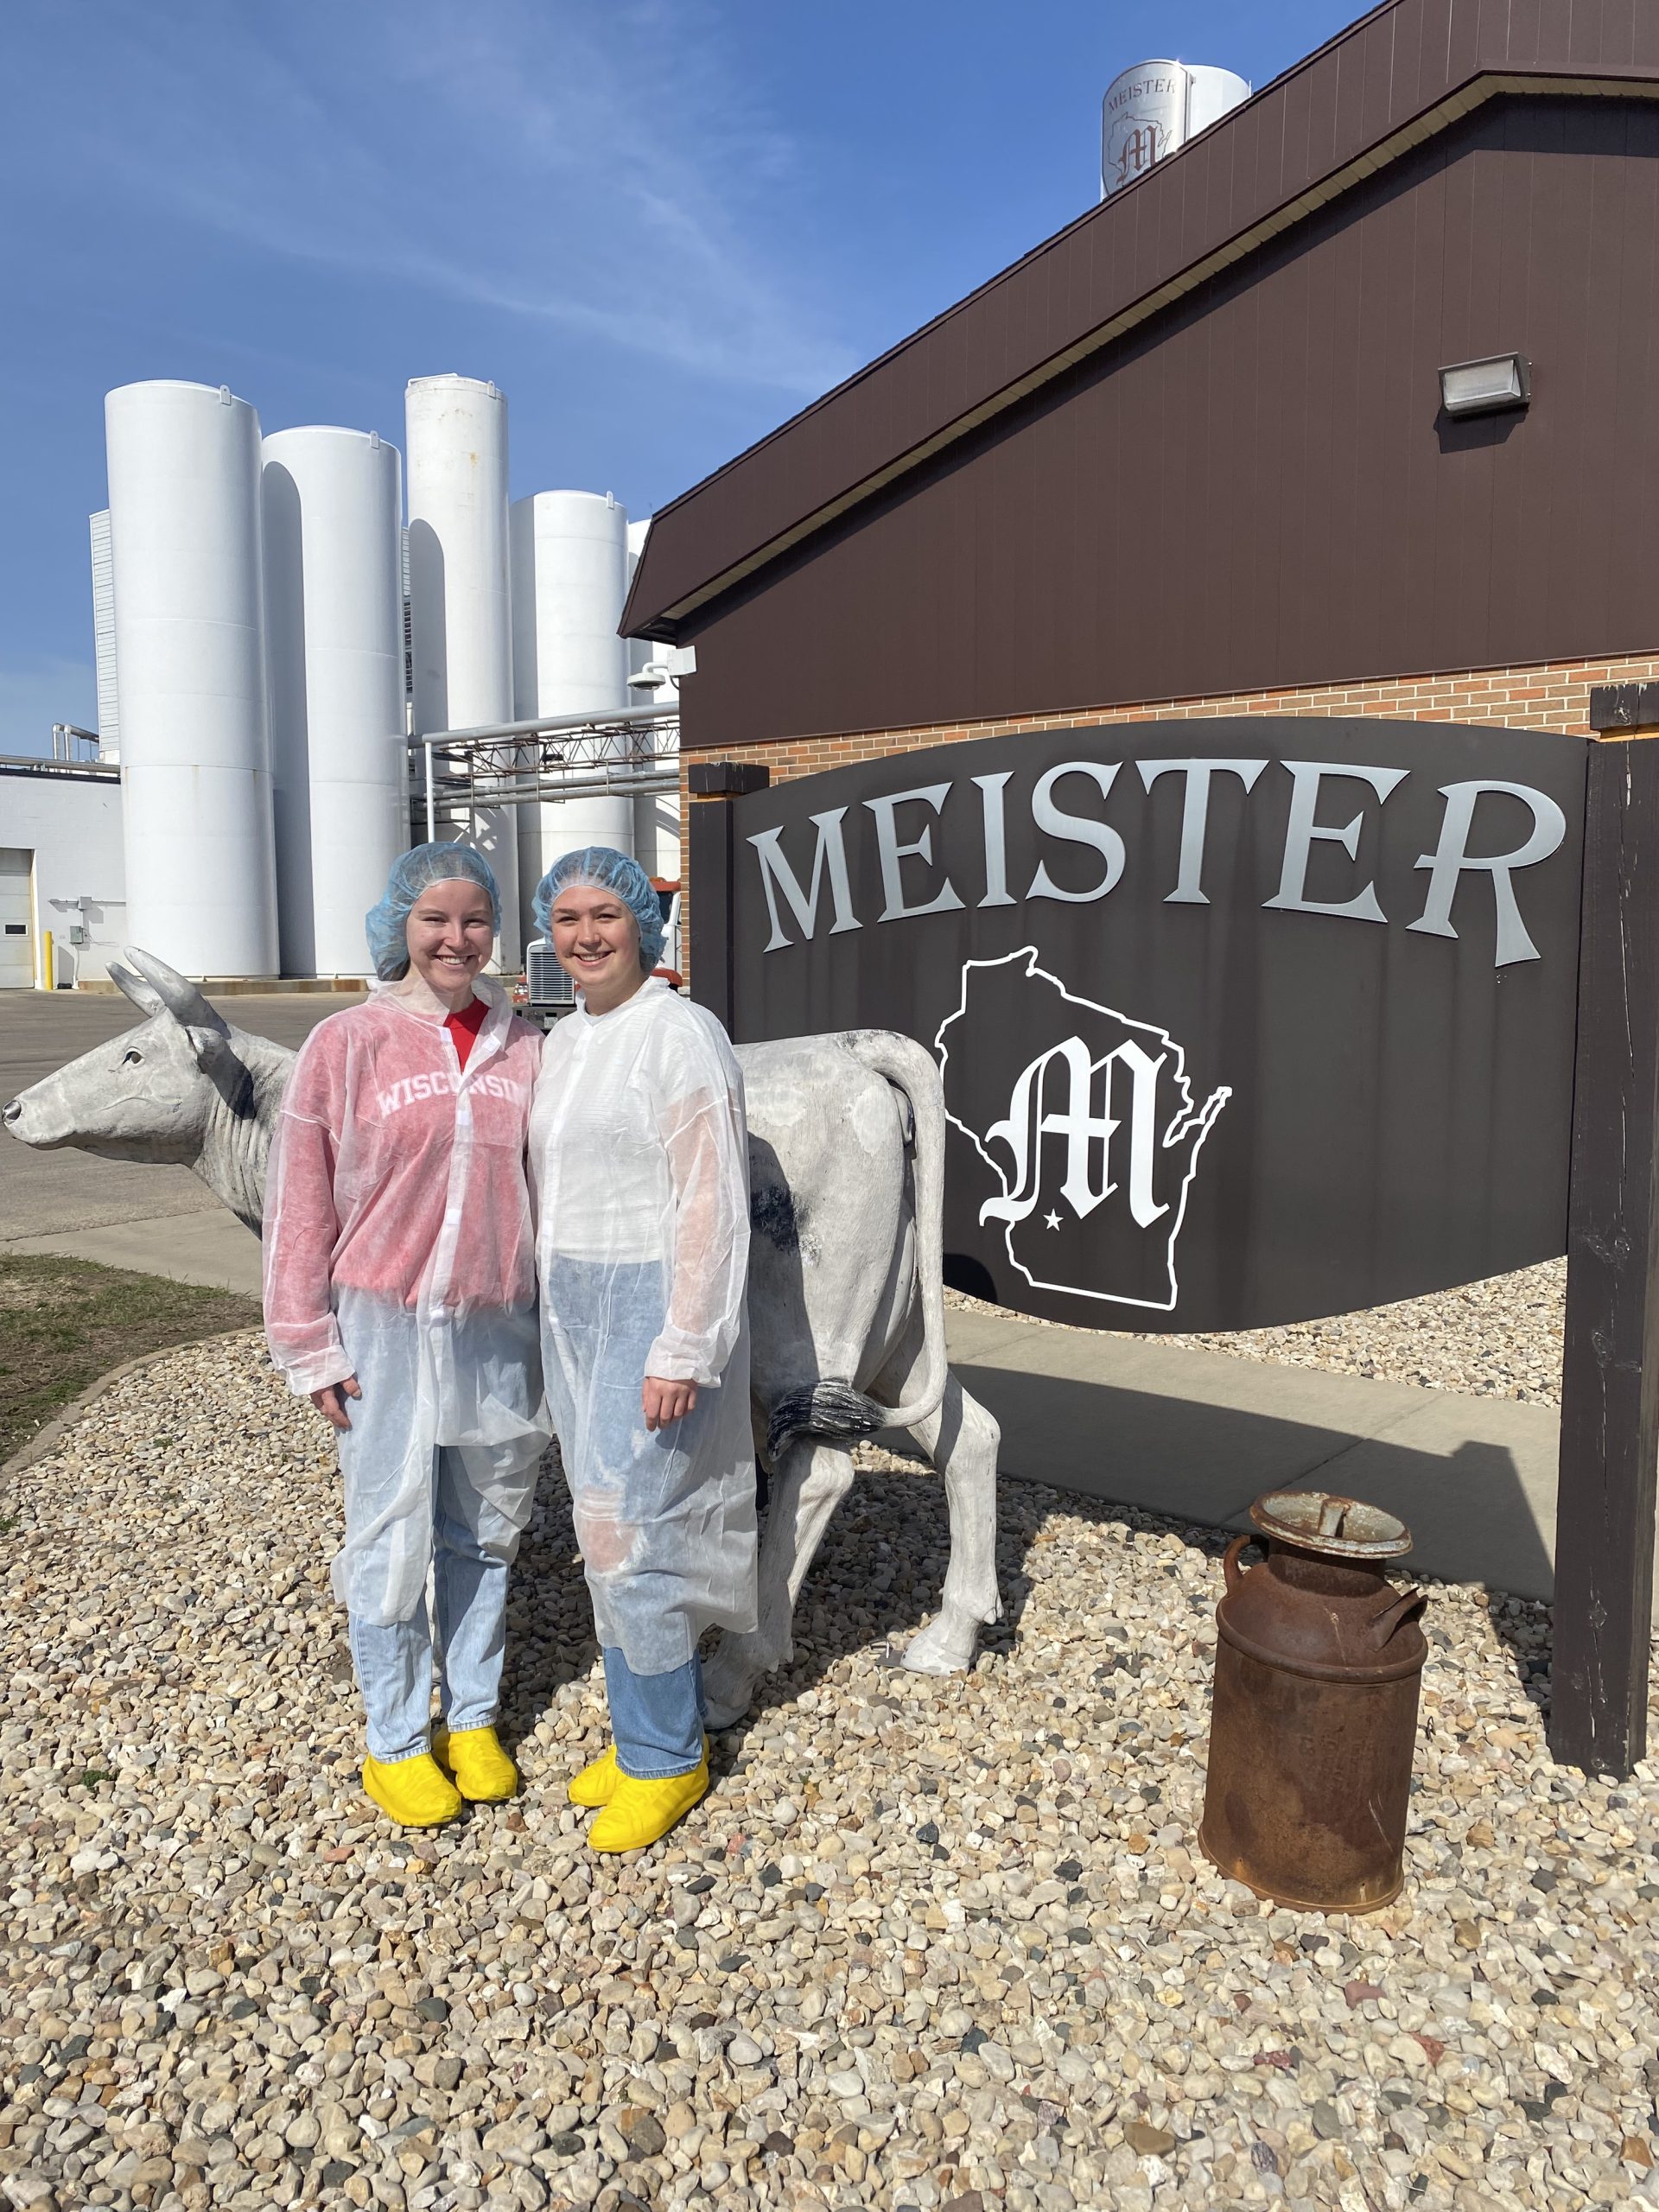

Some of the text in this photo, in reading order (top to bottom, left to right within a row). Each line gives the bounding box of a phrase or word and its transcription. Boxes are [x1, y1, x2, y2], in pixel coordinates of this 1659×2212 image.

[1109, 78, 1176, 113] MEISTER
[746, 758, 1567, 969] MEISTER
[979, 1035, 1171, 1229] M
